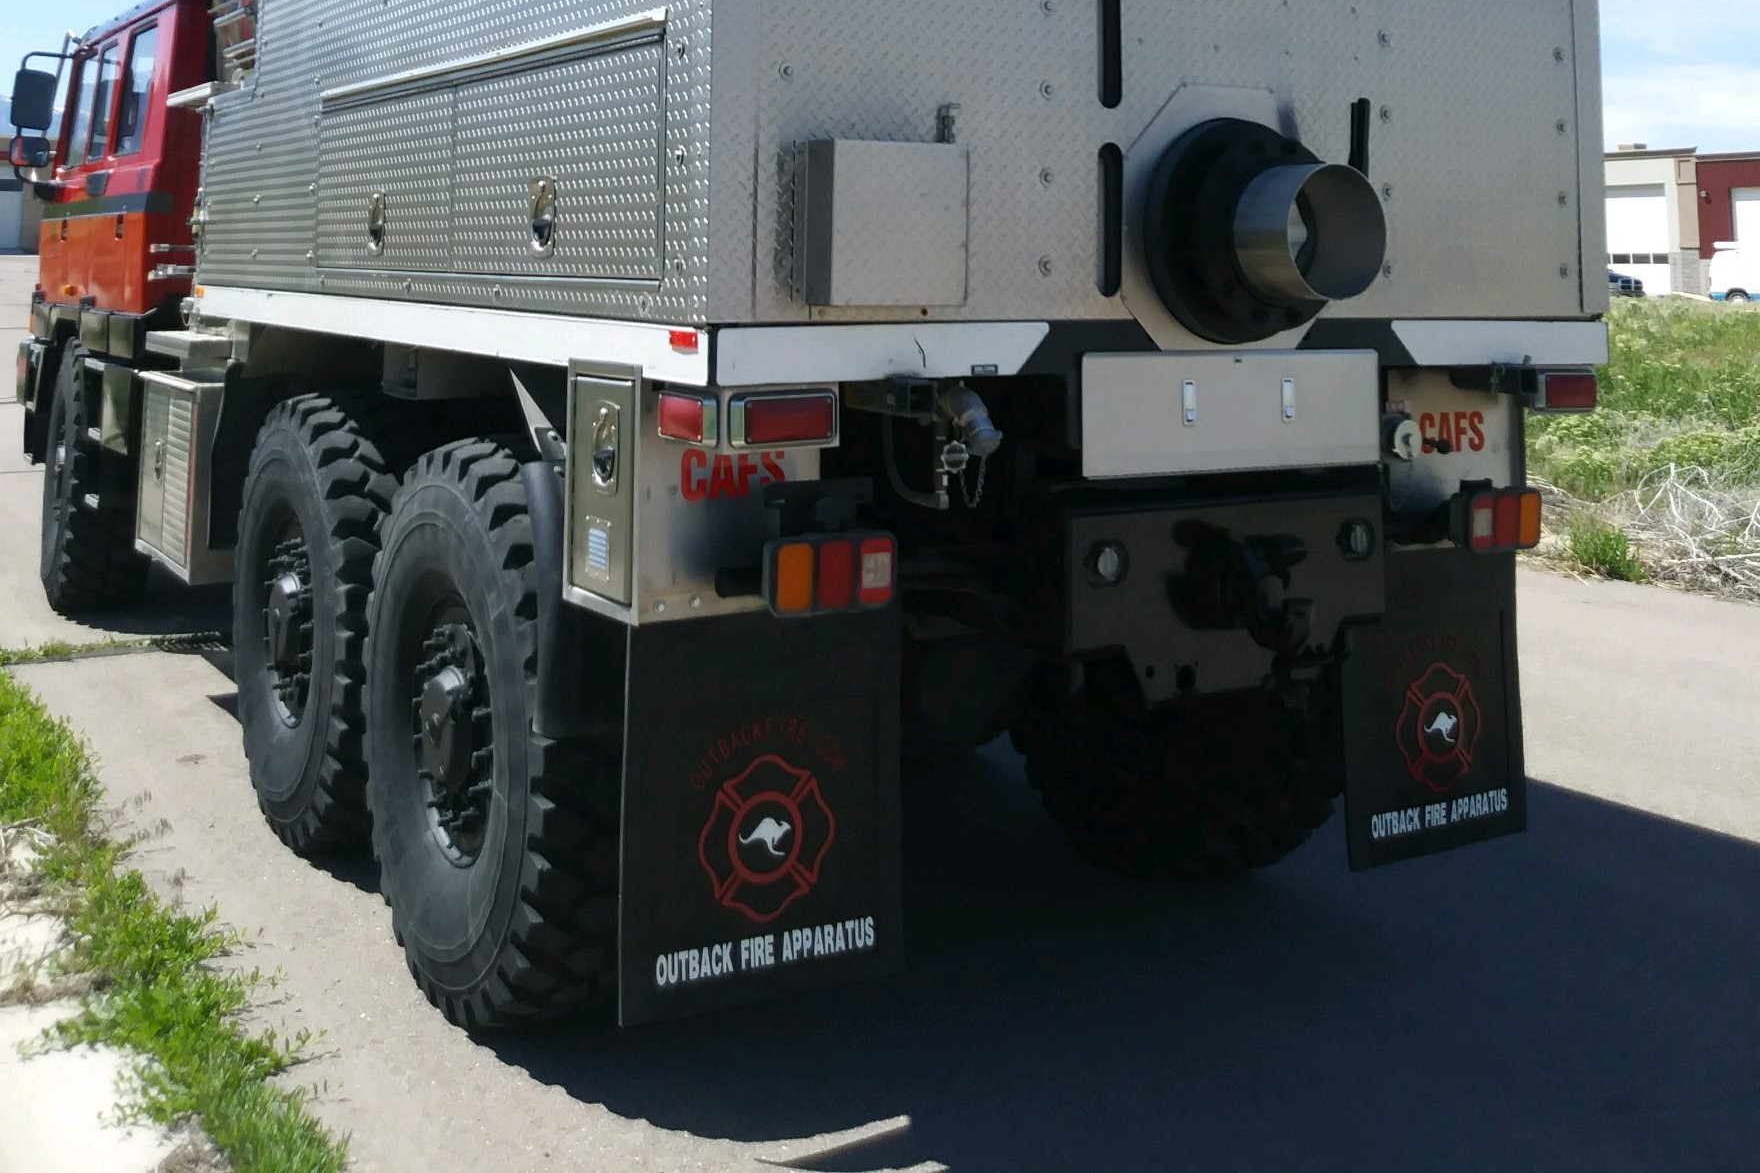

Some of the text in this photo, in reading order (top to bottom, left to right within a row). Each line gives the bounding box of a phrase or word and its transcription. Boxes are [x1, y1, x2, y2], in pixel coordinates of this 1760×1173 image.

[1419, 411, 1485, 454] CAFS
[680, 448, 786, 502] CAFS
[1371, 788, 1507, 839] OUTBACK FIRE APPARATUS
[656, 916, 875, 986] OUTBACK FIRE APPARATUS
